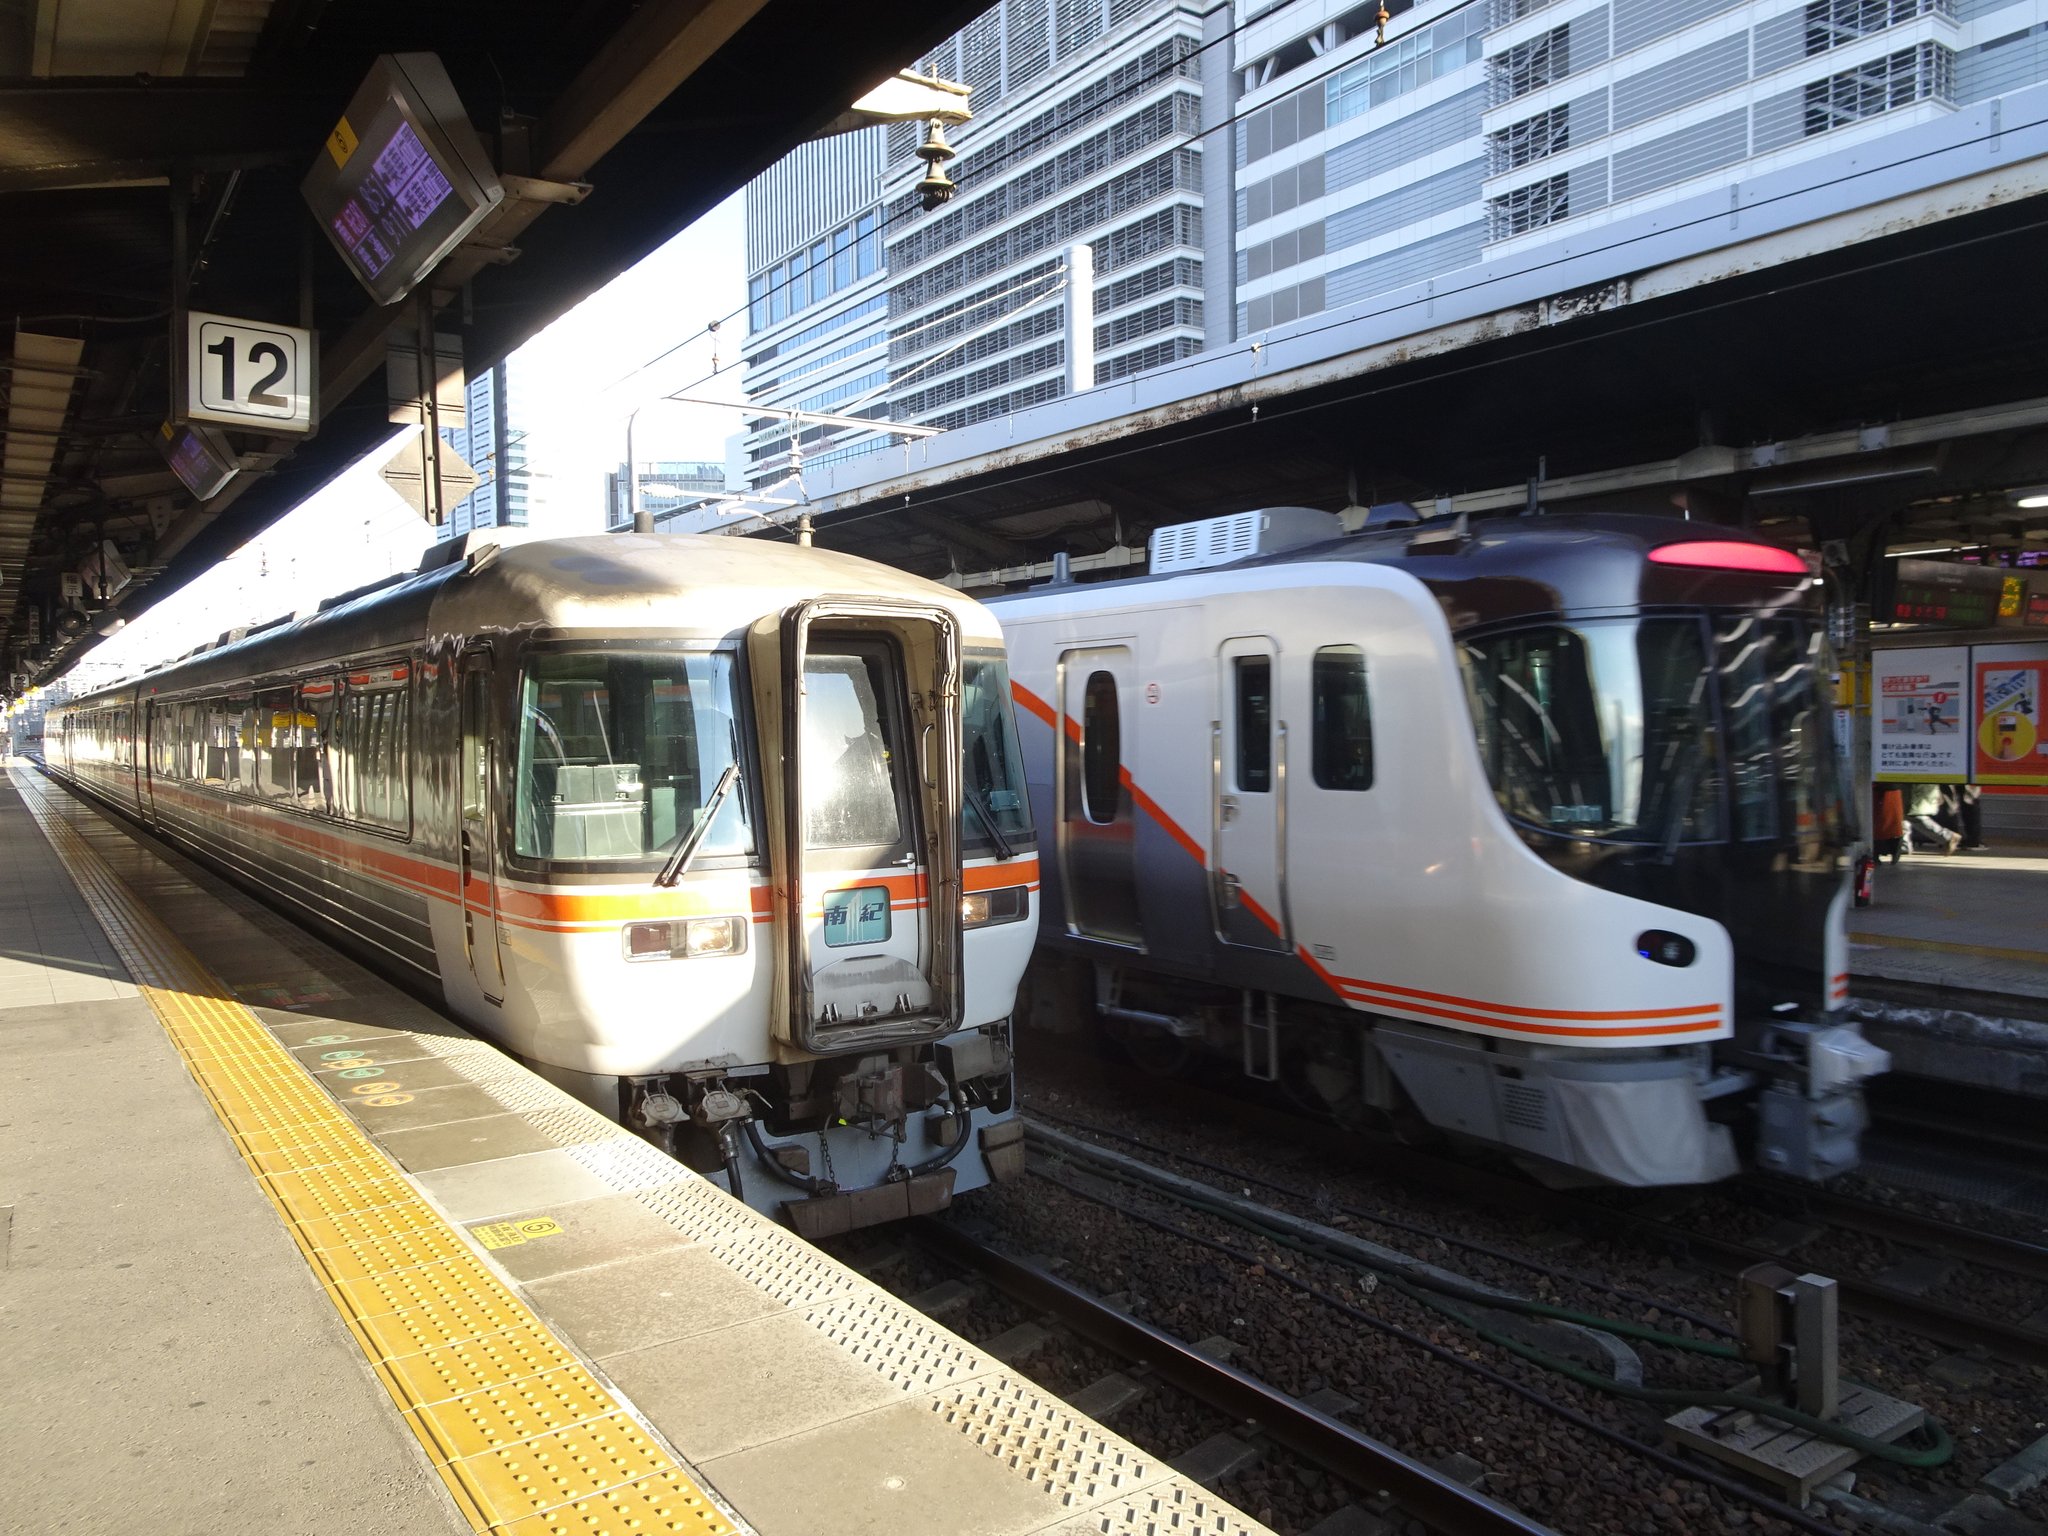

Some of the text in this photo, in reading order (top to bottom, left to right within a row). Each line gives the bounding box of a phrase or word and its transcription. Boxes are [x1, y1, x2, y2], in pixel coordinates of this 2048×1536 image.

[378, 123, 426, 187] 乗車位置
[402, 159, 450, 221] 乗車位置
[207, 336, 289, 408] 12
[824, 902, 884, 926] 南紀
